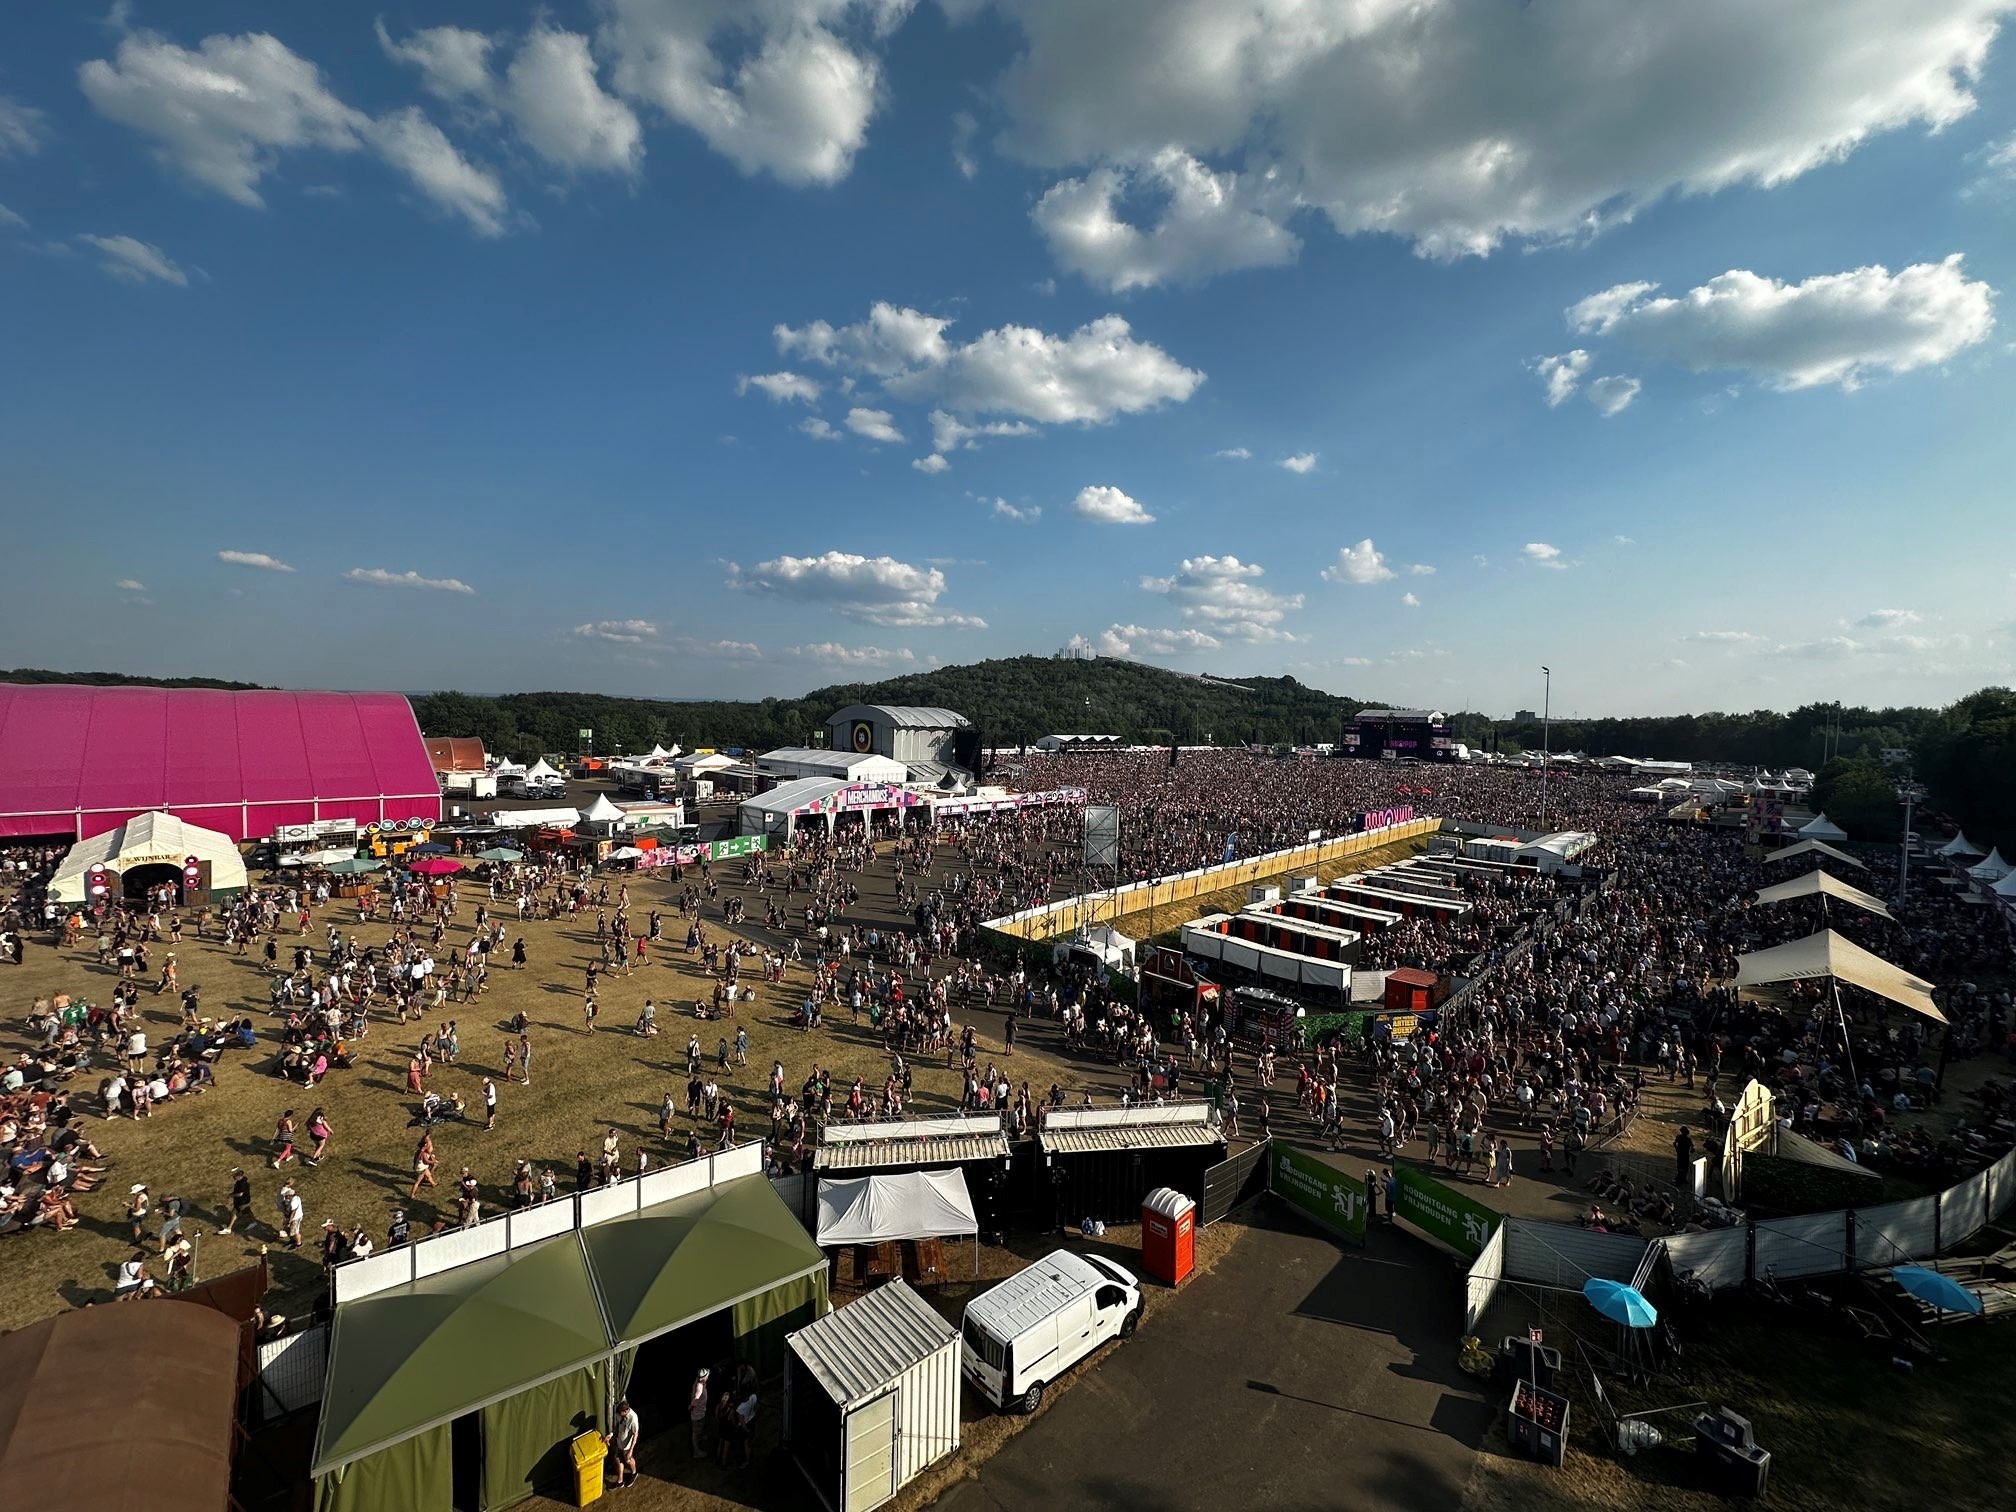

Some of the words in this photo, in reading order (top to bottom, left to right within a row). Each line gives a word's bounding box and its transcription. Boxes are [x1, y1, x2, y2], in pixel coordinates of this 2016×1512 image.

[848, 788, 889, 805] MERCHANDISE
[133, 854, 171, 862] WIJNBAR
[1280, 1170, 1322, 1199] VRIJHOUDEN
[1403, 1183, 1458, 1219] NOODUITGANG
[1403, 1192, 1451, 1226] VRIJHOUDEN
